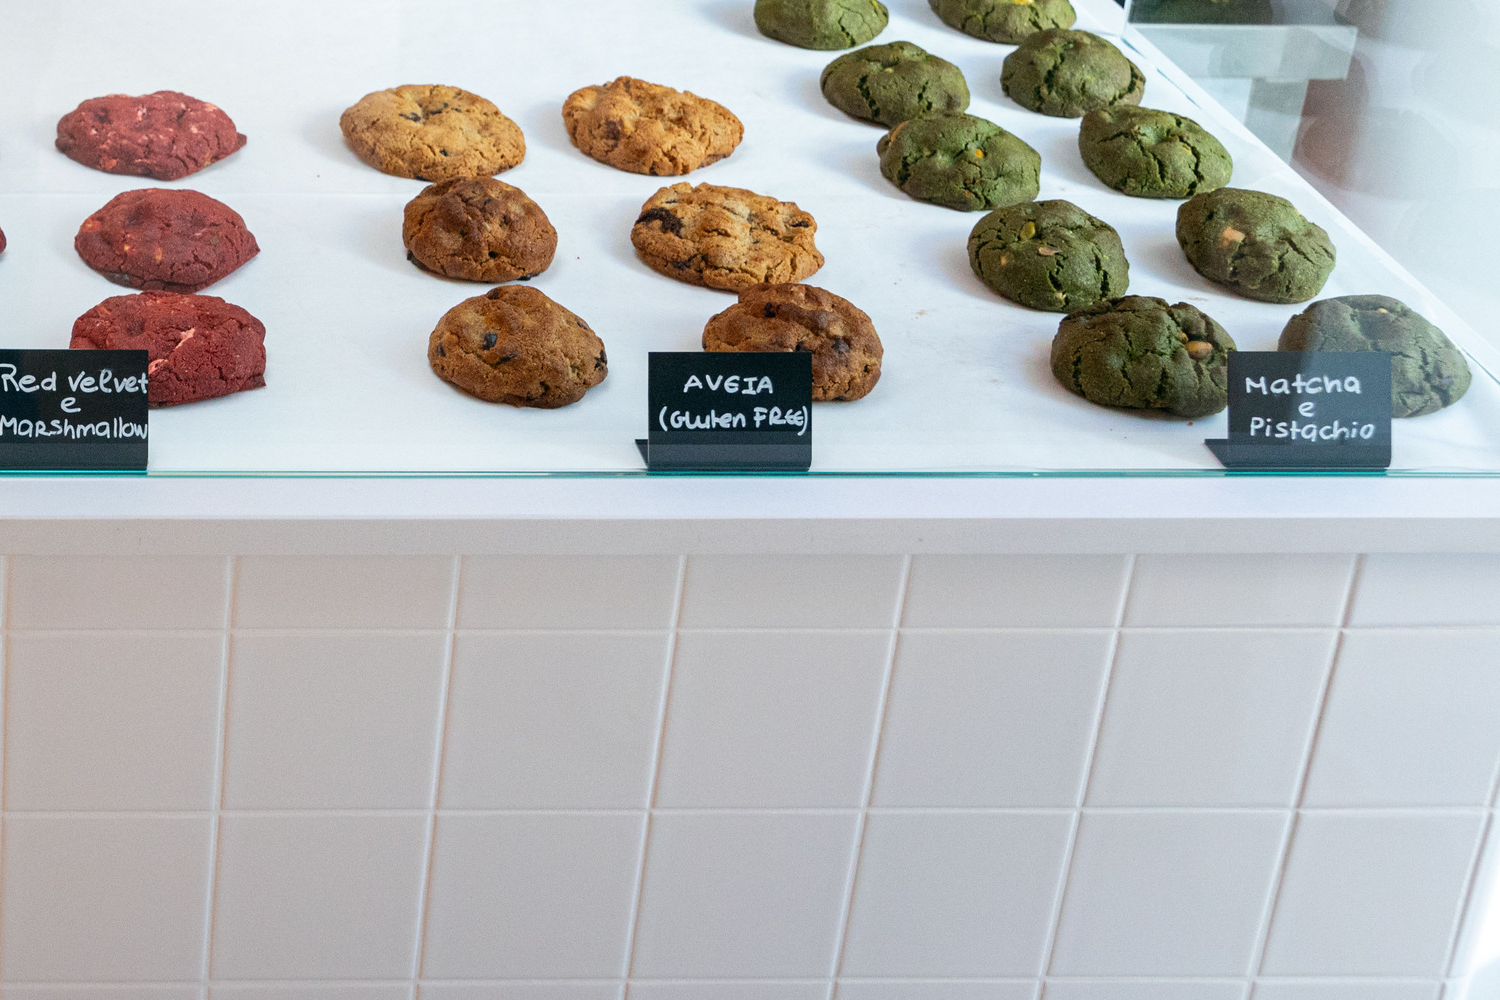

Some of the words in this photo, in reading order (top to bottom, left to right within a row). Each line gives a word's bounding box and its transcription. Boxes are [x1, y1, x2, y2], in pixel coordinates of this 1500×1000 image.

[683, 374, 774, 396] AVEIA
[1244, 372, 1363, 395] Matcha
[60, 396, 82, 413] e
[1298, 401, 1315, 418] e
[1249, 416, 1376, 442] Pistachio
